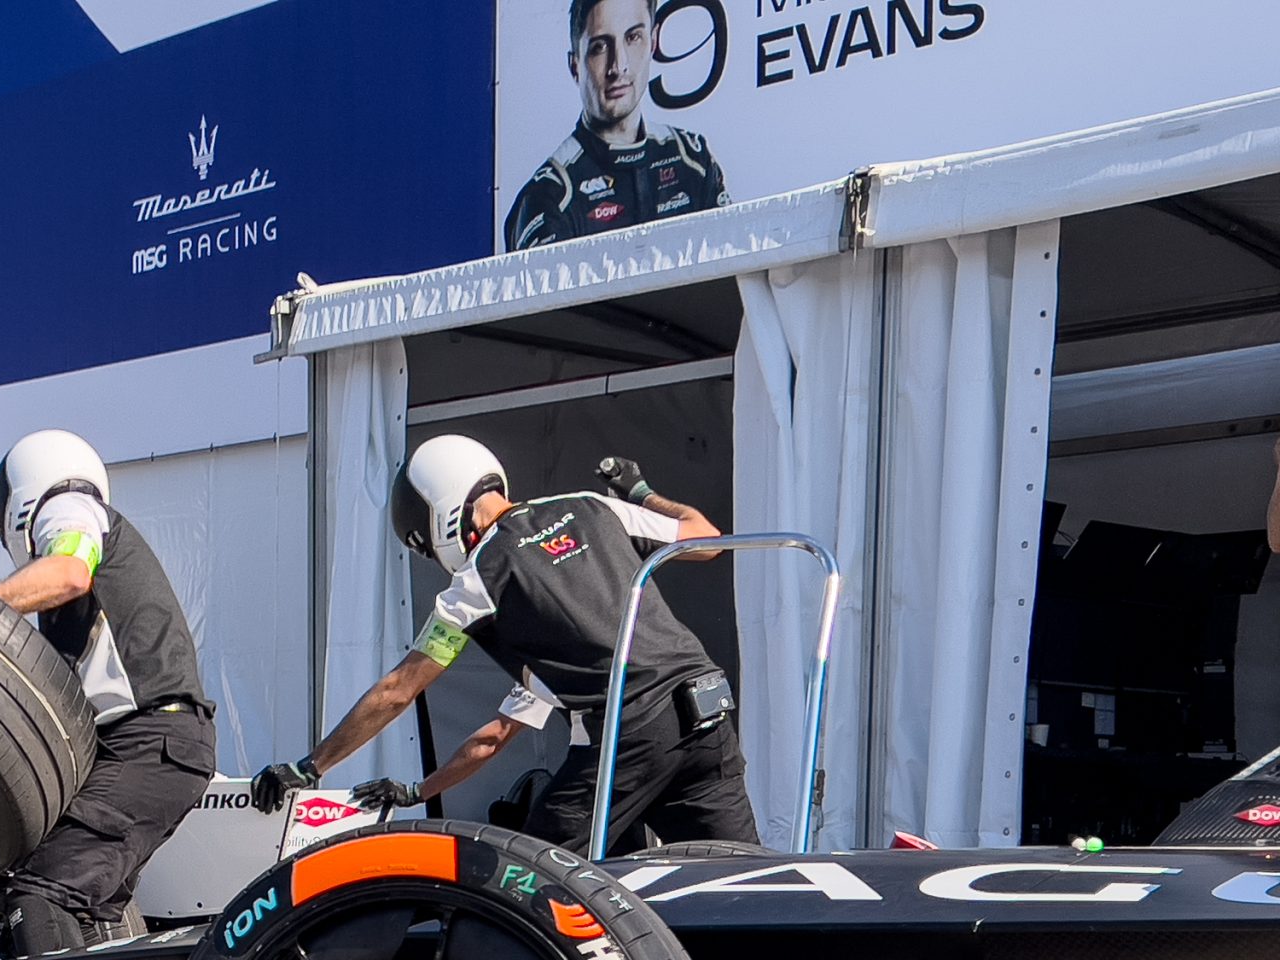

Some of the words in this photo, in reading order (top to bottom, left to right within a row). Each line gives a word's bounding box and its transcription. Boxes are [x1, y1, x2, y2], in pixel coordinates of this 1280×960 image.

[648, 0, 728, 110] 9
[756, 0, 985, 88] EVANS
[132, 167, 276, 222] Maserati
[132, 244, 167, 274] MSG
[179, 216, 277, 263] RACING
